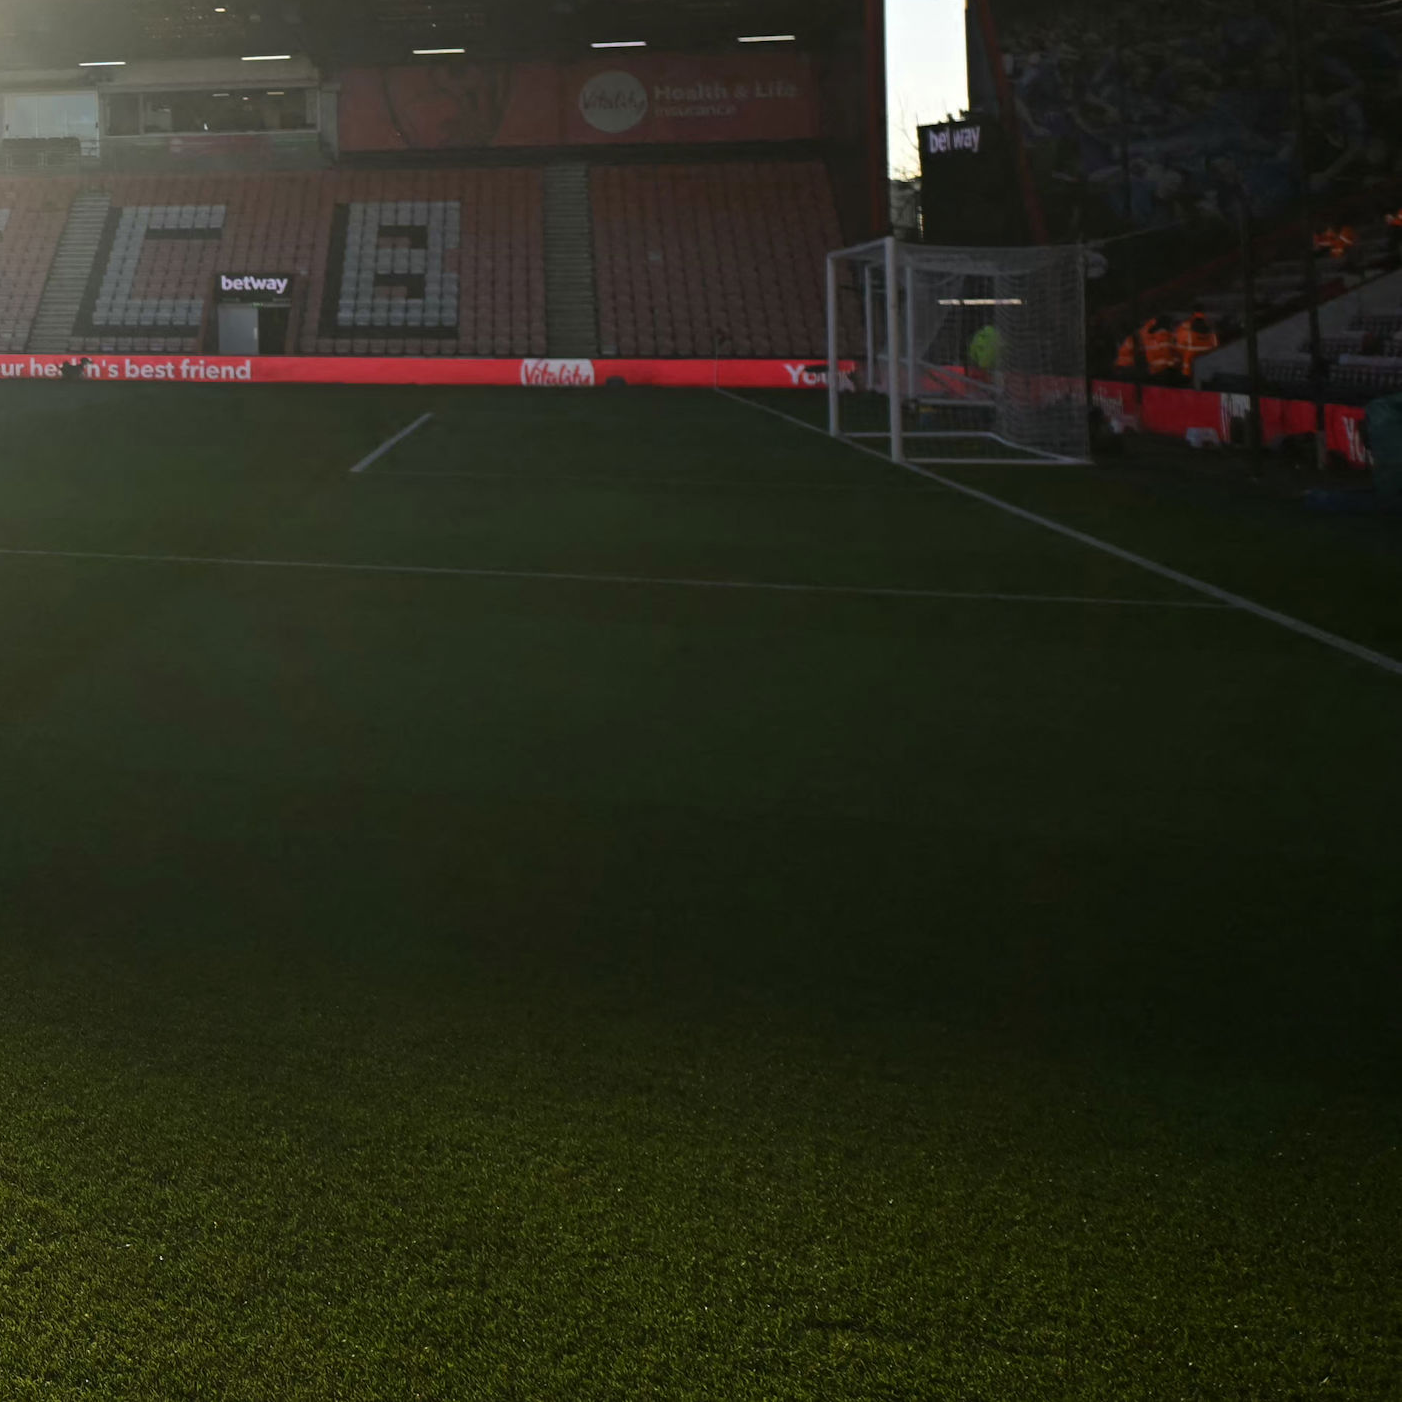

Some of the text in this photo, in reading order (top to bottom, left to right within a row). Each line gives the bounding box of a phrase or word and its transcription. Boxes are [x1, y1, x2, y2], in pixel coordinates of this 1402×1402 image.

[221, 275, 288, 294] betway
[124, 358, 174, 379] best
[180, 358, 252, 381] friend
